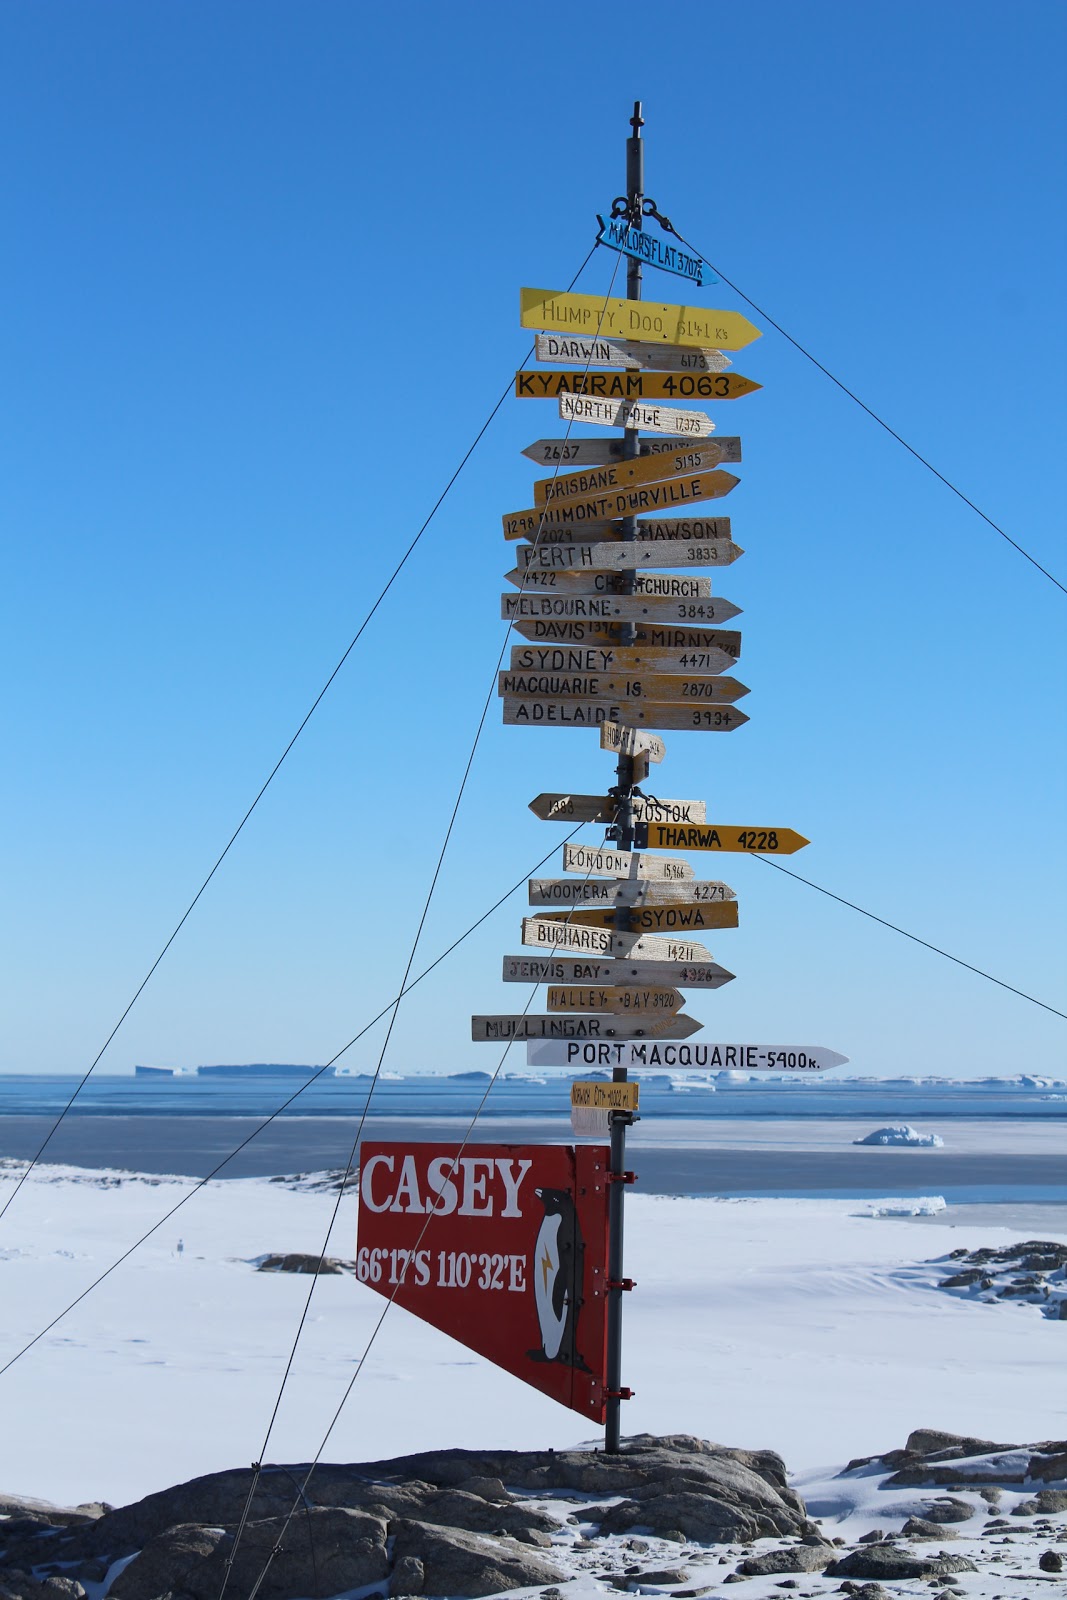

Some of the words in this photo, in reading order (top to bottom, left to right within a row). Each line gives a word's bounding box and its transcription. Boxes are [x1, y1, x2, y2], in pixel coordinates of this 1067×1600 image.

[677, 321, 711, 339] 6141
[549, 340, 611, 361] DARWIN
[681, 355, 705, 369] 6173
[519, 374, 643, 396] KYABRAM
[662, 376, 730, 396] 4063
[565, 398, 613, 420] NORTH
[622, 407, 661, 427] POLE
[543, 445, 580, 460] 2637
[545, 469, 618, 501] BRISBANE
[675, 453, 702, 471] 5195
[507, 516, 535, 534] 1298
[616, 480, 702, 512] D'URVILLE
[541, 528, 573, 542] 2029
[639, 522, 718, 541] MAWSON
[524, 546, 593, 567] PERTH
[687, 548, 718, 561] 3833
[506, 598, 611, 616] MELBOURNE
[678, 605, 715, 619] 3843
[535, 621, 585, 640] DAVIS
[652, 630, 715, 648] MIRNY
[518, 650, 612, 670] SYDNEY
[680, 654, 710, 668] 4471
[504, 676, 599, 694] MACQUARIE
[626, 681, 647, 698] IS.
[682, 683, 713, 697] 2870
[516, 703, 620, 723] ADELAIDE
[693, 711, 732, 726] 3934
[633, 802, 691, 822] VOSTOK
[657, 827, 721, 848] THARWA
[738, 831, 779, 850] 4228
[569, 849, 622, 871] LONDON
[540, 885, 608, 899] WOOMERA
[694, 886, 724, 900] 4279
[641, 909, 705, 927] SYOWA
[538, 925, 617, 951] BUCHAREST
[510, 962, 564, 978] JERVIS
[574, 964, 600, 979] BAY
[551, 991, 606, 1007] HALLEY
[624, 992, 650, 1008] BAY
[486, 1020, 600, 1037] MULLINGAR
[568, 1042, 625, 1064] PORT
[361, 1155, 532, 1218] CASEY
